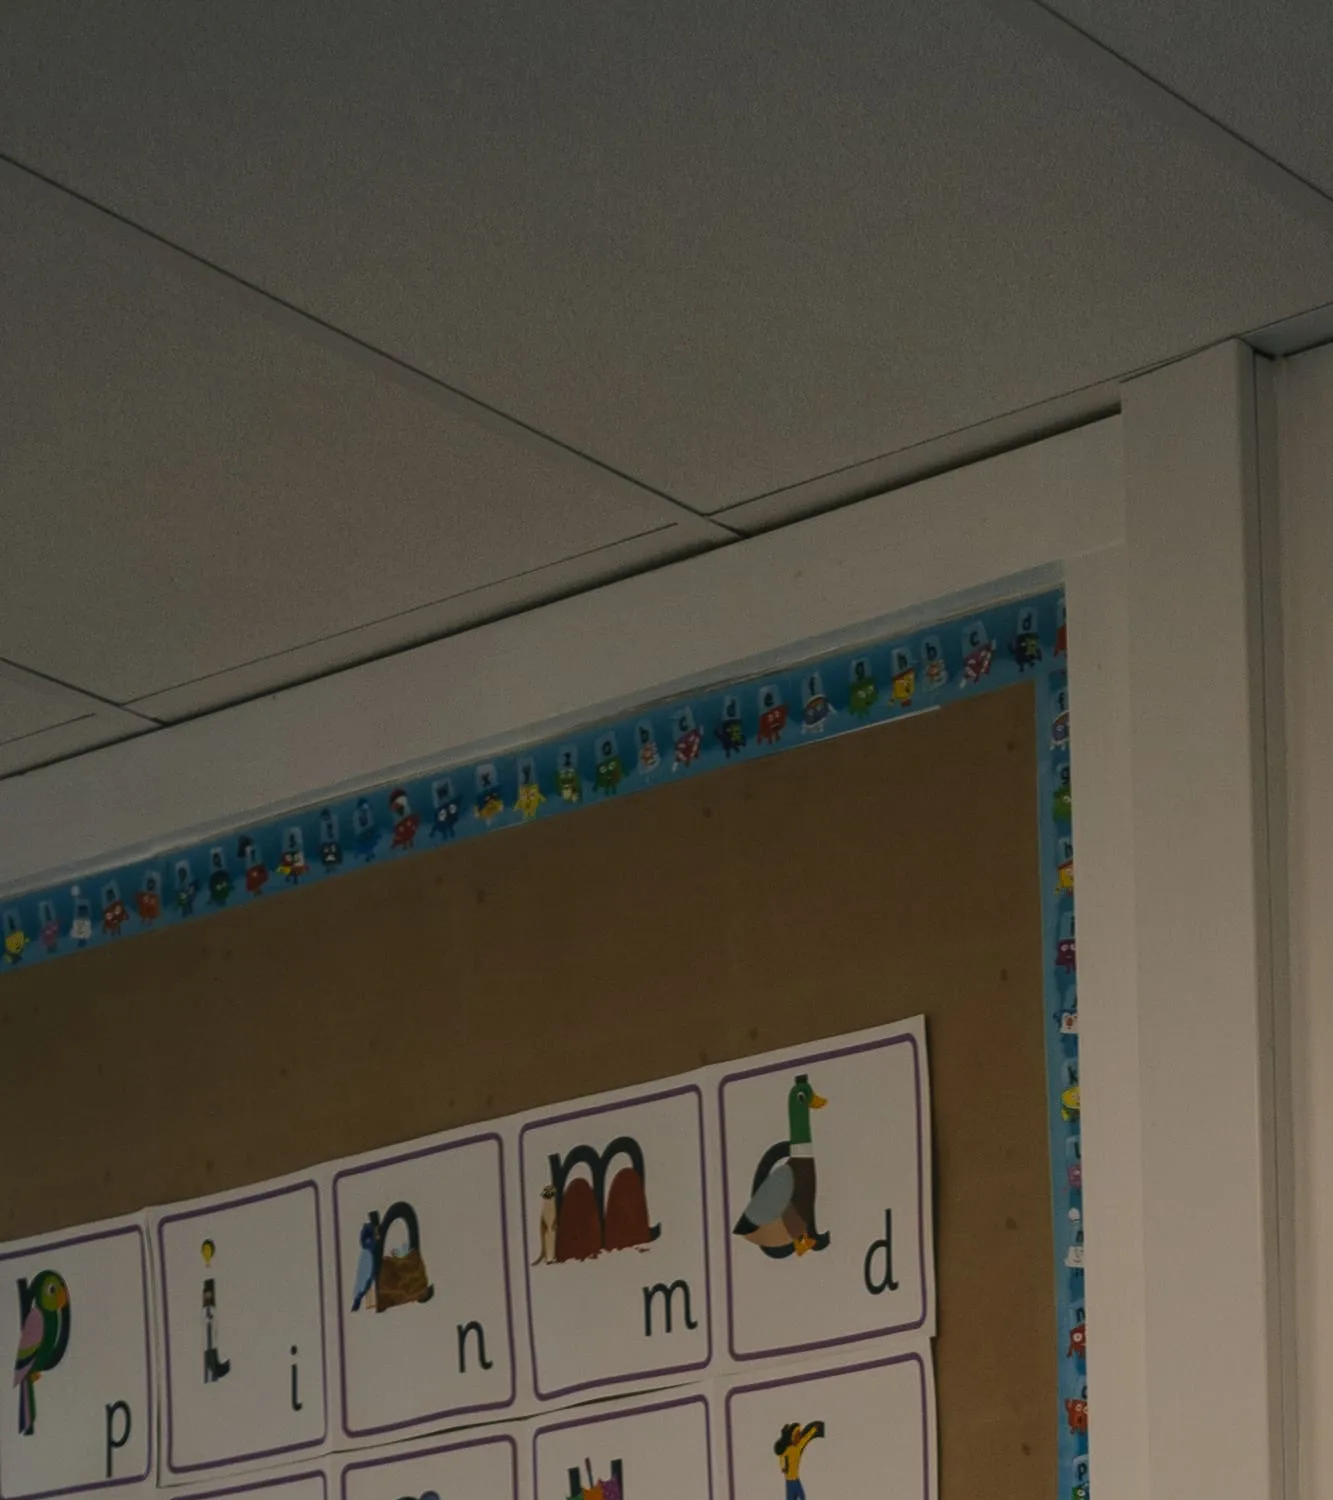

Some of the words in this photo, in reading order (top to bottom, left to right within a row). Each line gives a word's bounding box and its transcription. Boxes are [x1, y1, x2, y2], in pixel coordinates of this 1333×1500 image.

[863, 1208, 899, 1296] d
[642, 1279, 698, 1338] m
[289, 1345, 303, 1412] i
[457, 1320, 493, 1373] n
[105, 1401, 132, 1478] p
